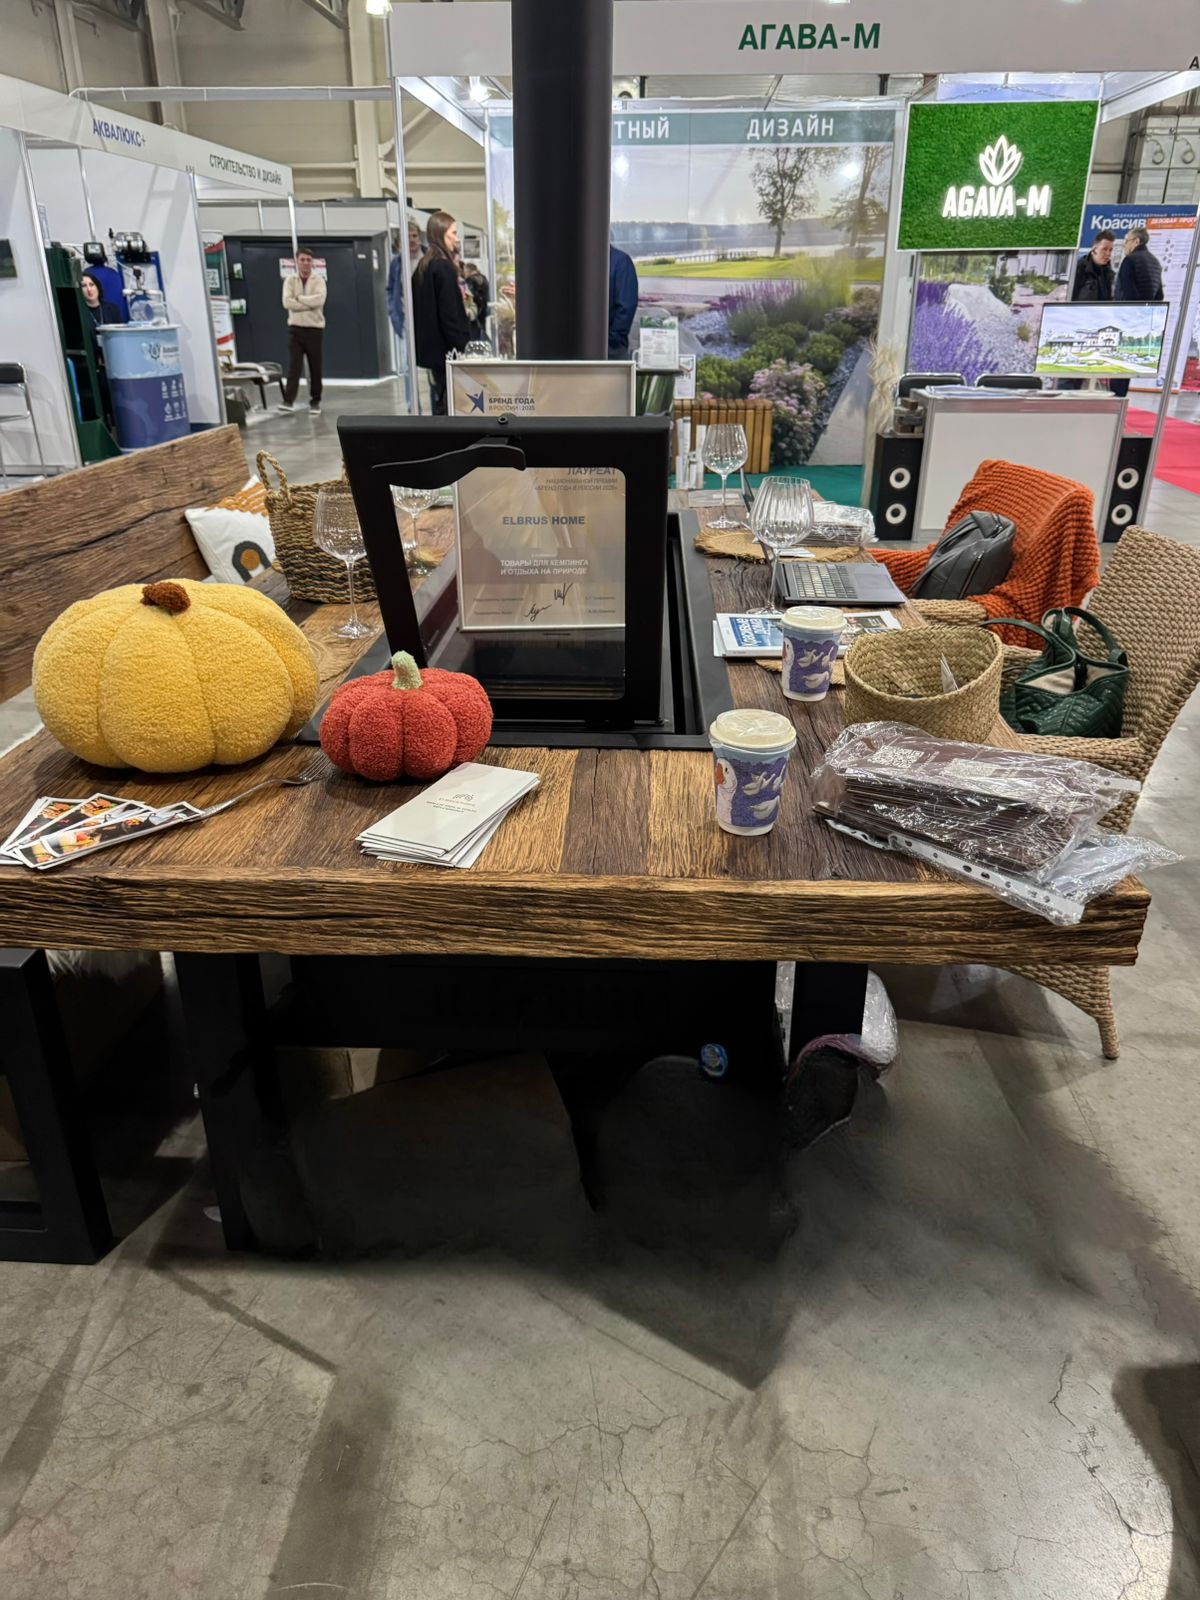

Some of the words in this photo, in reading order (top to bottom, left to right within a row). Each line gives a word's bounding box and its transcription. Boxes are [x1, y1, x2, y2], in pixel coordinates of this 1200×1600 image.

[738, 23, 881, 50] АГАВА-М
[746, 114, 834, 140] ДИЗАЙН
[209, 154, 256, 178] СТРОИТЕЛЬСТВО
[262, 169, 282, 185] ДИЗАЙН
[942, 185, 1051, 218] AGAVA-M
[488, 397, 512, 405] БРЕНД
[514, 397, 535, 405] ГОДА
[502, 516, 548, 525] ELBRUS
[551, 515, 585, 525] HOME
[500, 559, 532, 567] ТОВАРЫ
[533, 559, 548, 567] ДЛЯ
[550, 559, 589, 567] КЕМПИНГА
[507, 568, 539, 576] ОТДЫХА
[552, 567, 587, 575] ПРИРОДЕ
